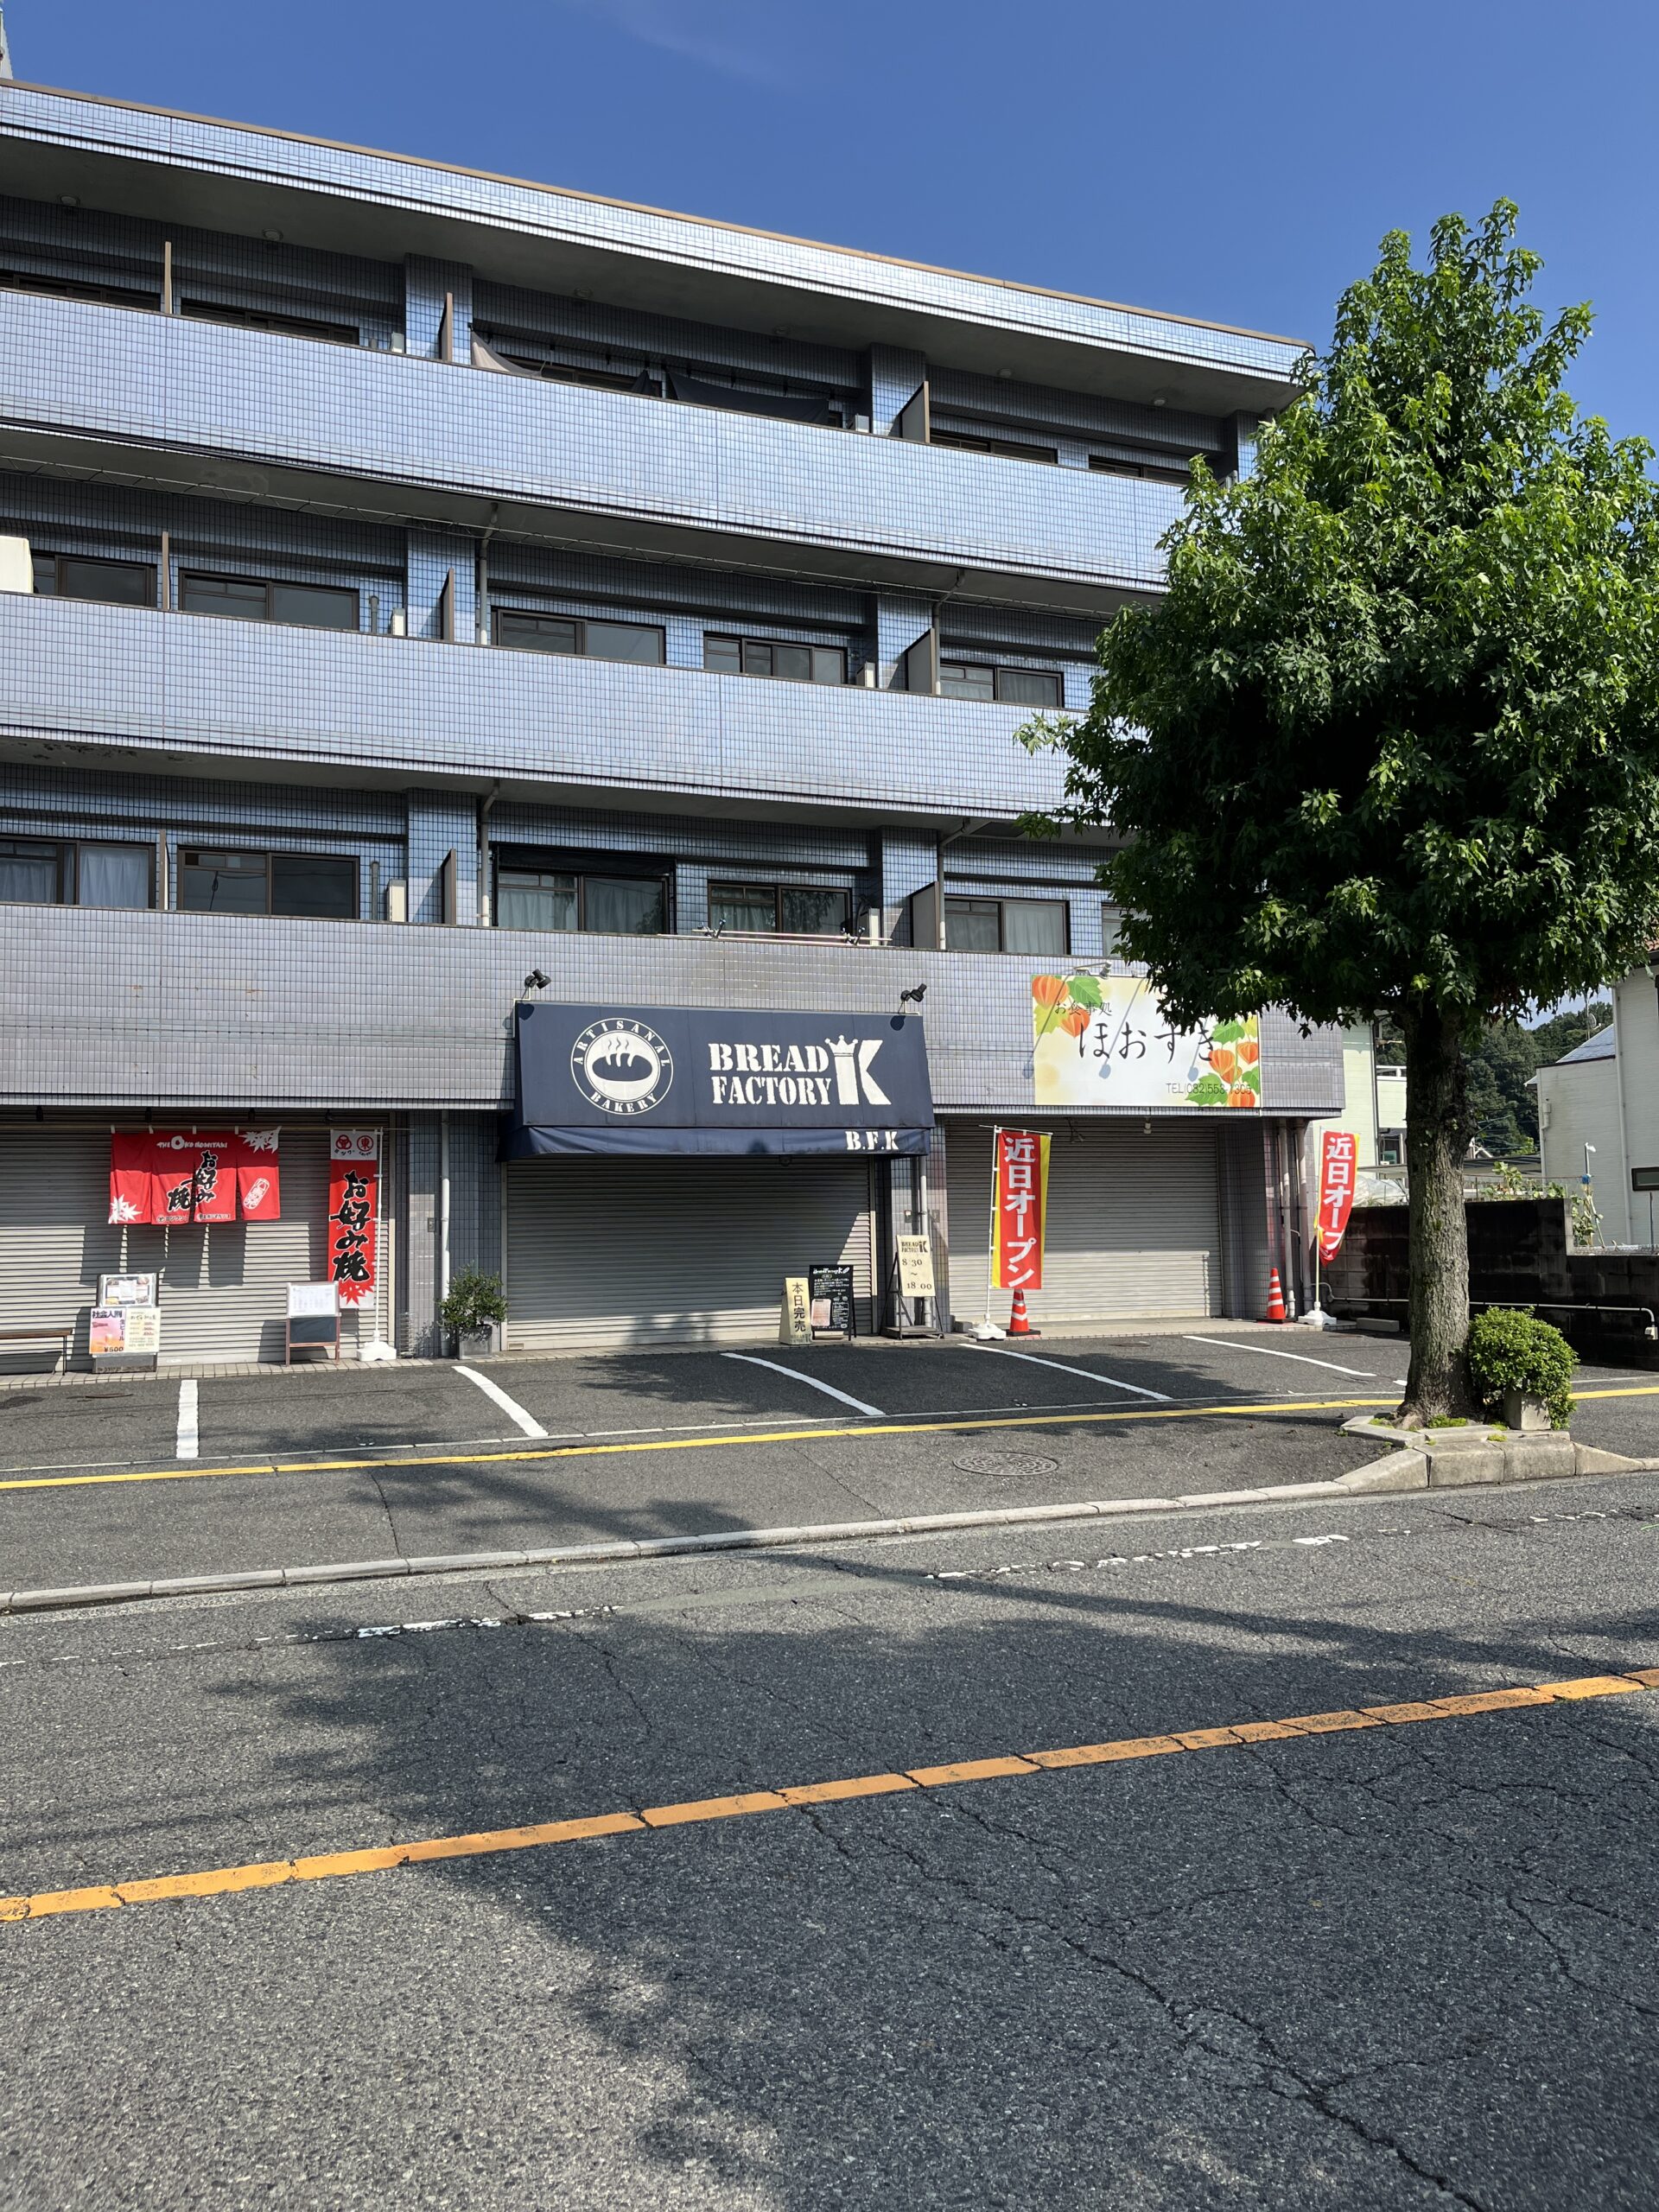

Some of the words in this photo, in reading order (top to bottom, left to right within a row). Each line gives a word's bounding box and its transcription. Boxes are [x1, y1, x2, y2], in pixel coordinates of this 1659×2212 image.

[573, 1020, 671, 1066] ARTISANAL
[708, 1043, 830, 1072] BREAD
[710, 1076, 832, 1105] FACTORY
[831, 1037, 892, 1105] K
[590, 1091, 657, 1113] BAKERY
[845, 1130, 899, 1150] B.F.K
[328, 1170, 372, 1282] お好み焼
[1004, 1137, 1037, 1287] 近日オープン
[791, 1282, 806, 1332] 本日完売
